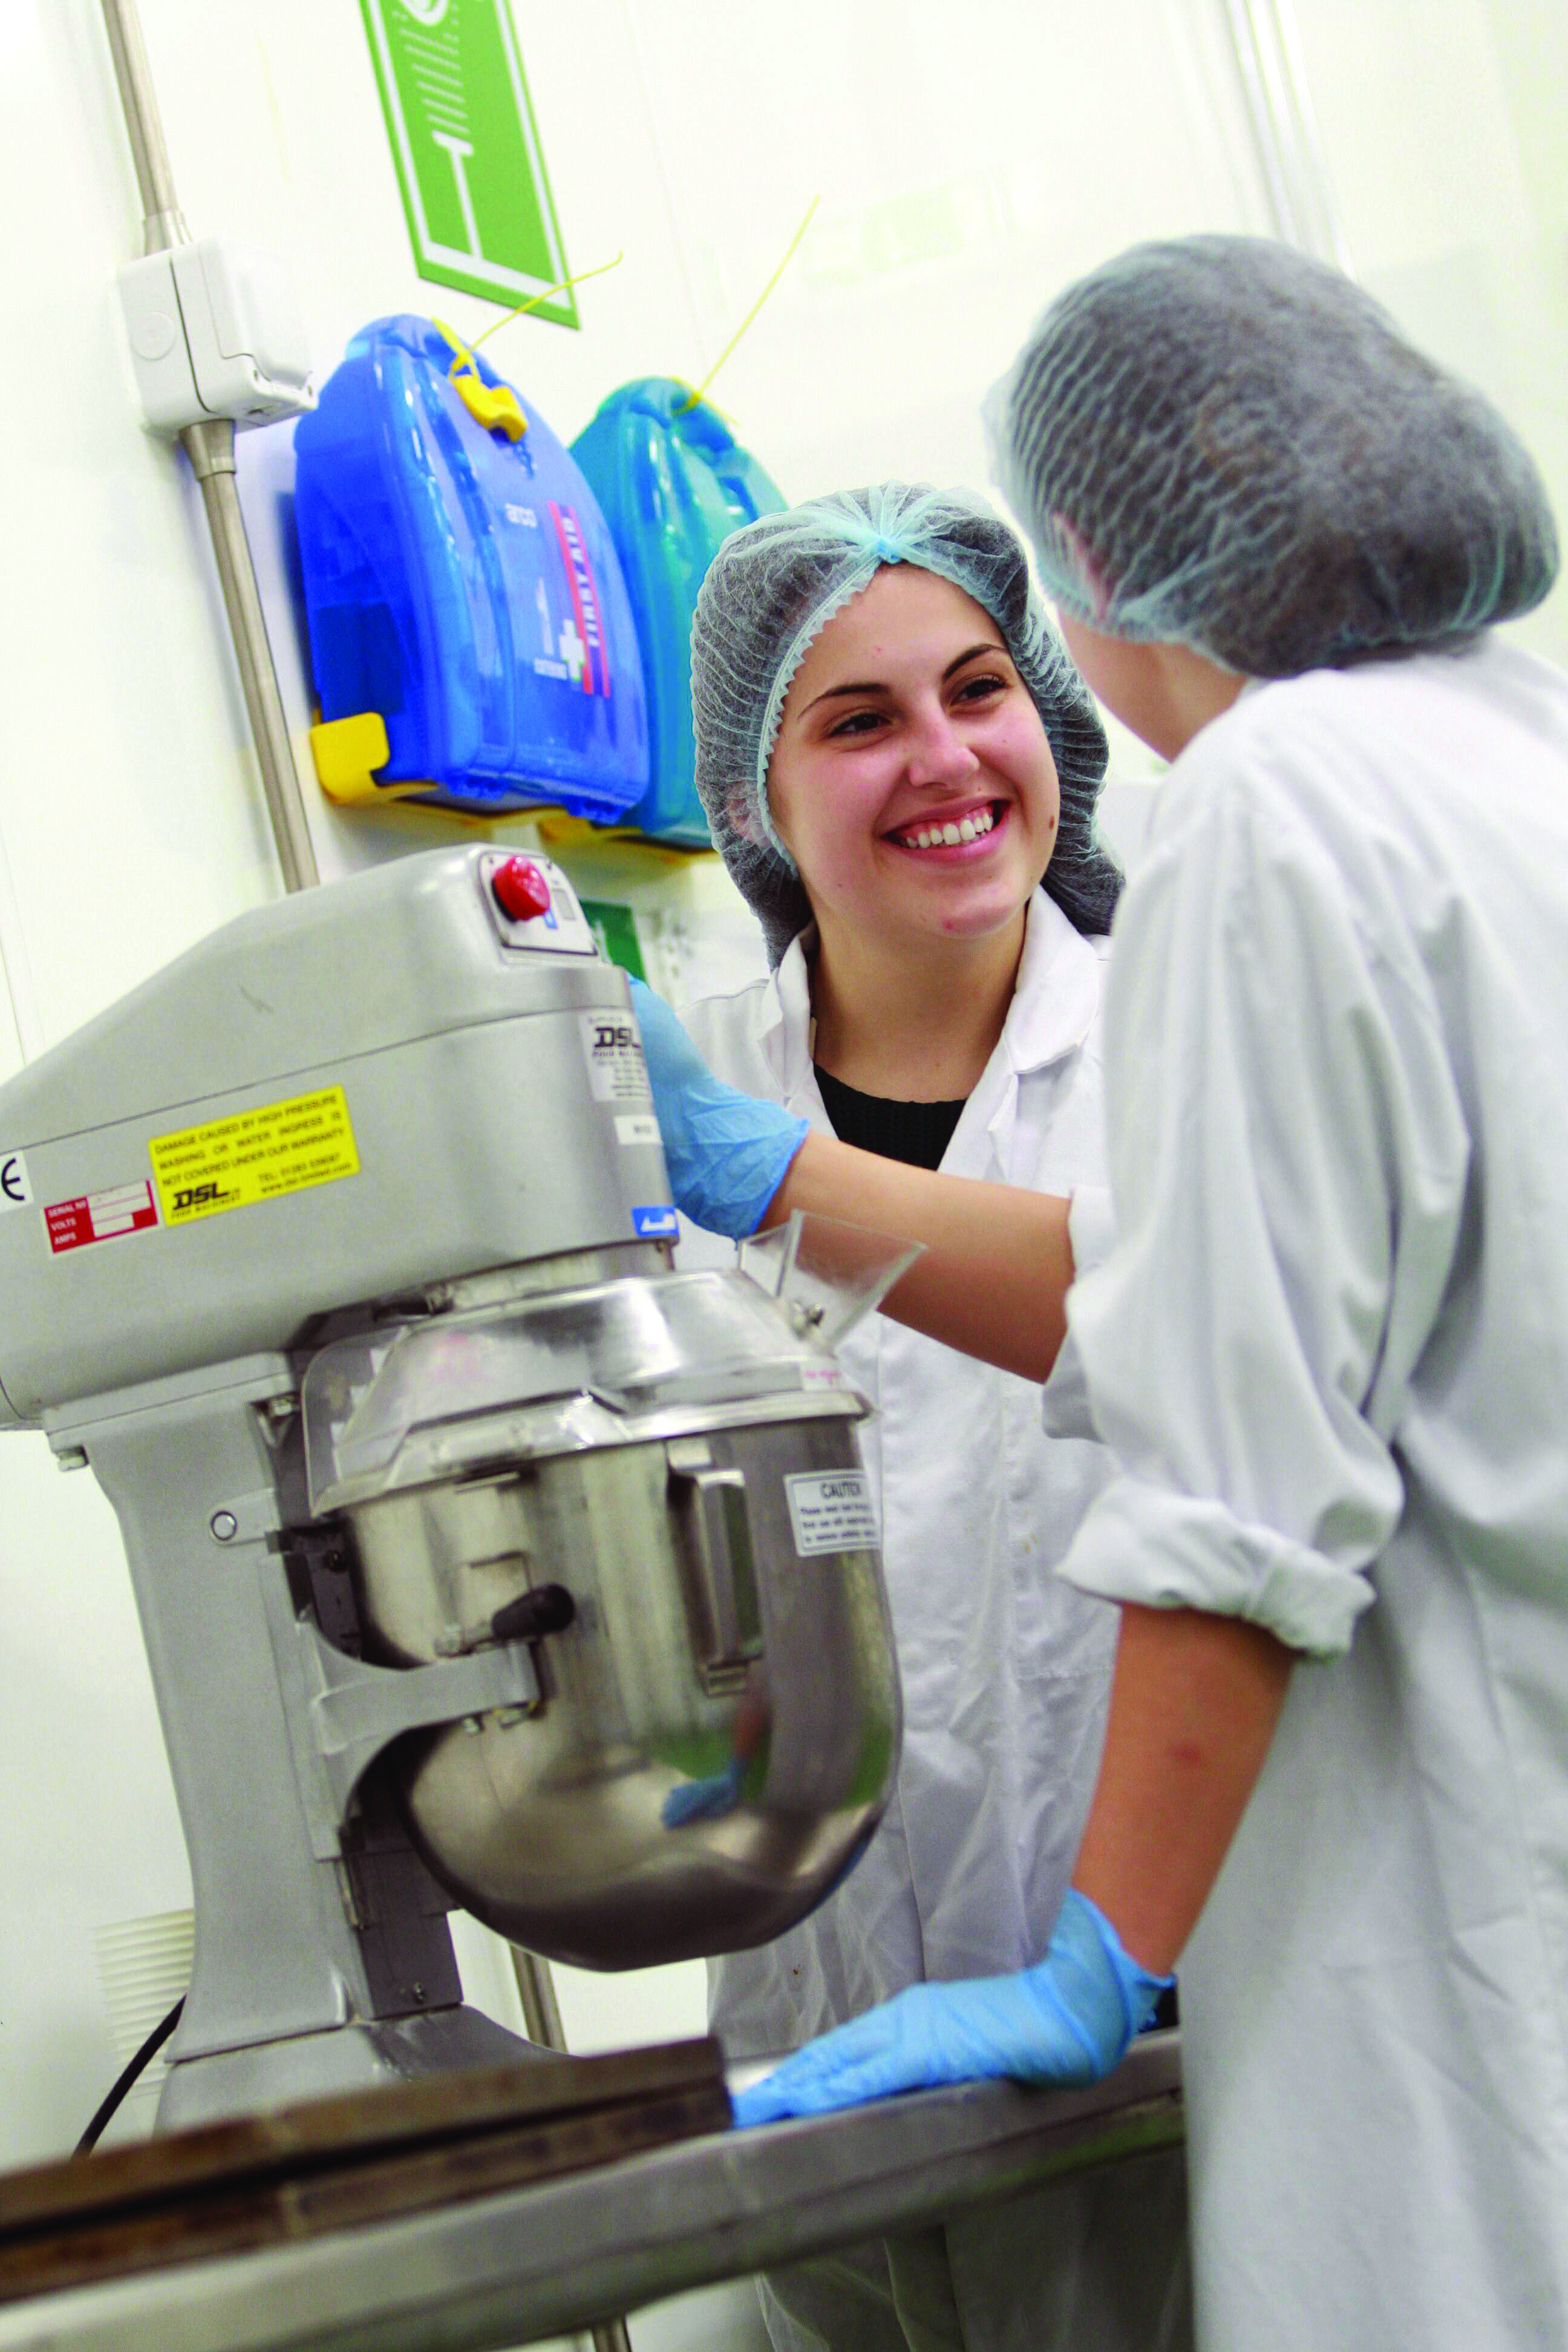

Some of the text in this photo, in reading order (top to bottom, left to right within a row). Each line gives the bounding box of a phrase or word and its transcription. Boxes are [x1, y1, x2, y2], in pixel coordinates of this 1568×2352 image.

[155, 1094, 336, 1154] DAMAGE CAUSED BY HIGH PRESSURE
[158, 1111, 340, 1170] WASHING OR WATER INGRESS IS
[162, 1127, 344, 1186] NOT COVERED UNDER OUR WARRANTY
[173, 1182, 229, 1209] DSL
